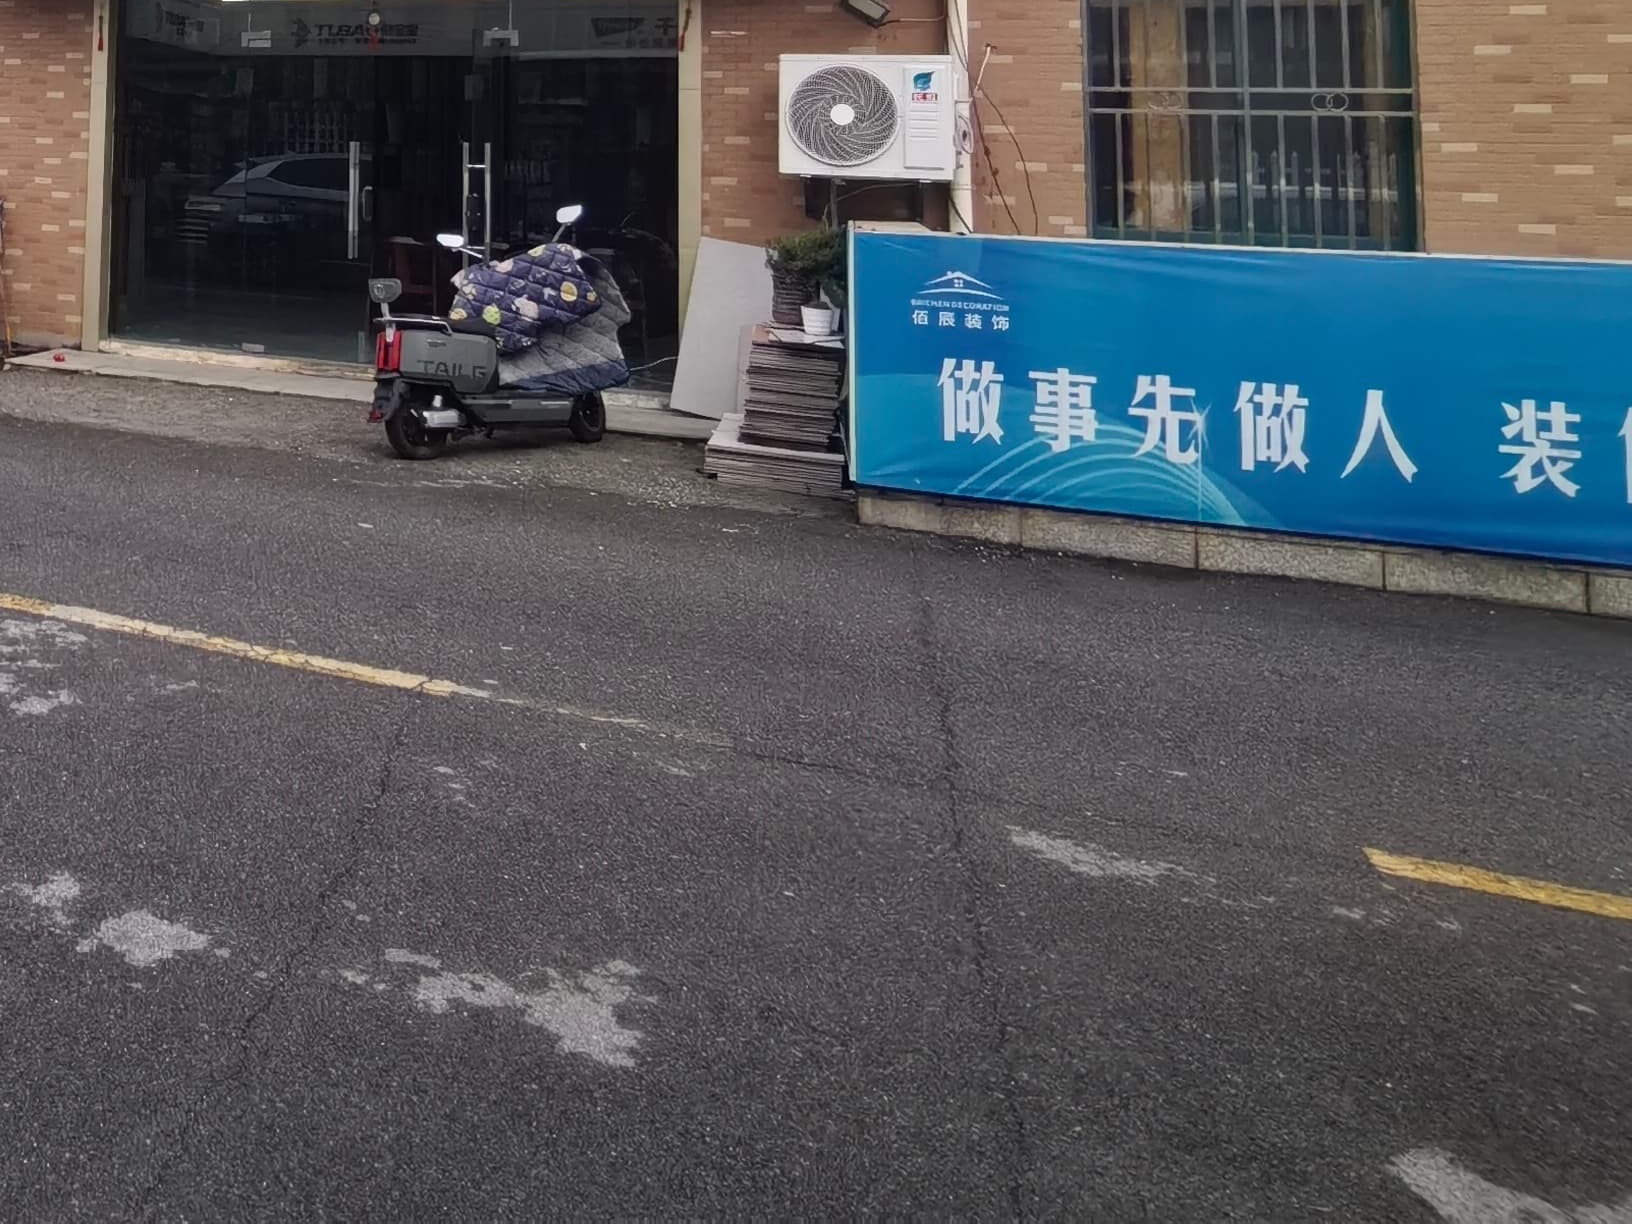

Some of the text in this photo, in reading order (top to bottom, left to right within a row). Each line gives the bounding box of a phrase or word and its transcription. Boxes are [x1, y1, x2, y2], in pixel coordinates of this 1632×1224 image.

[911, 309, 1010, 331] 佰辰装饰
[937, 357, 1632, 504] 做事先做人 装
